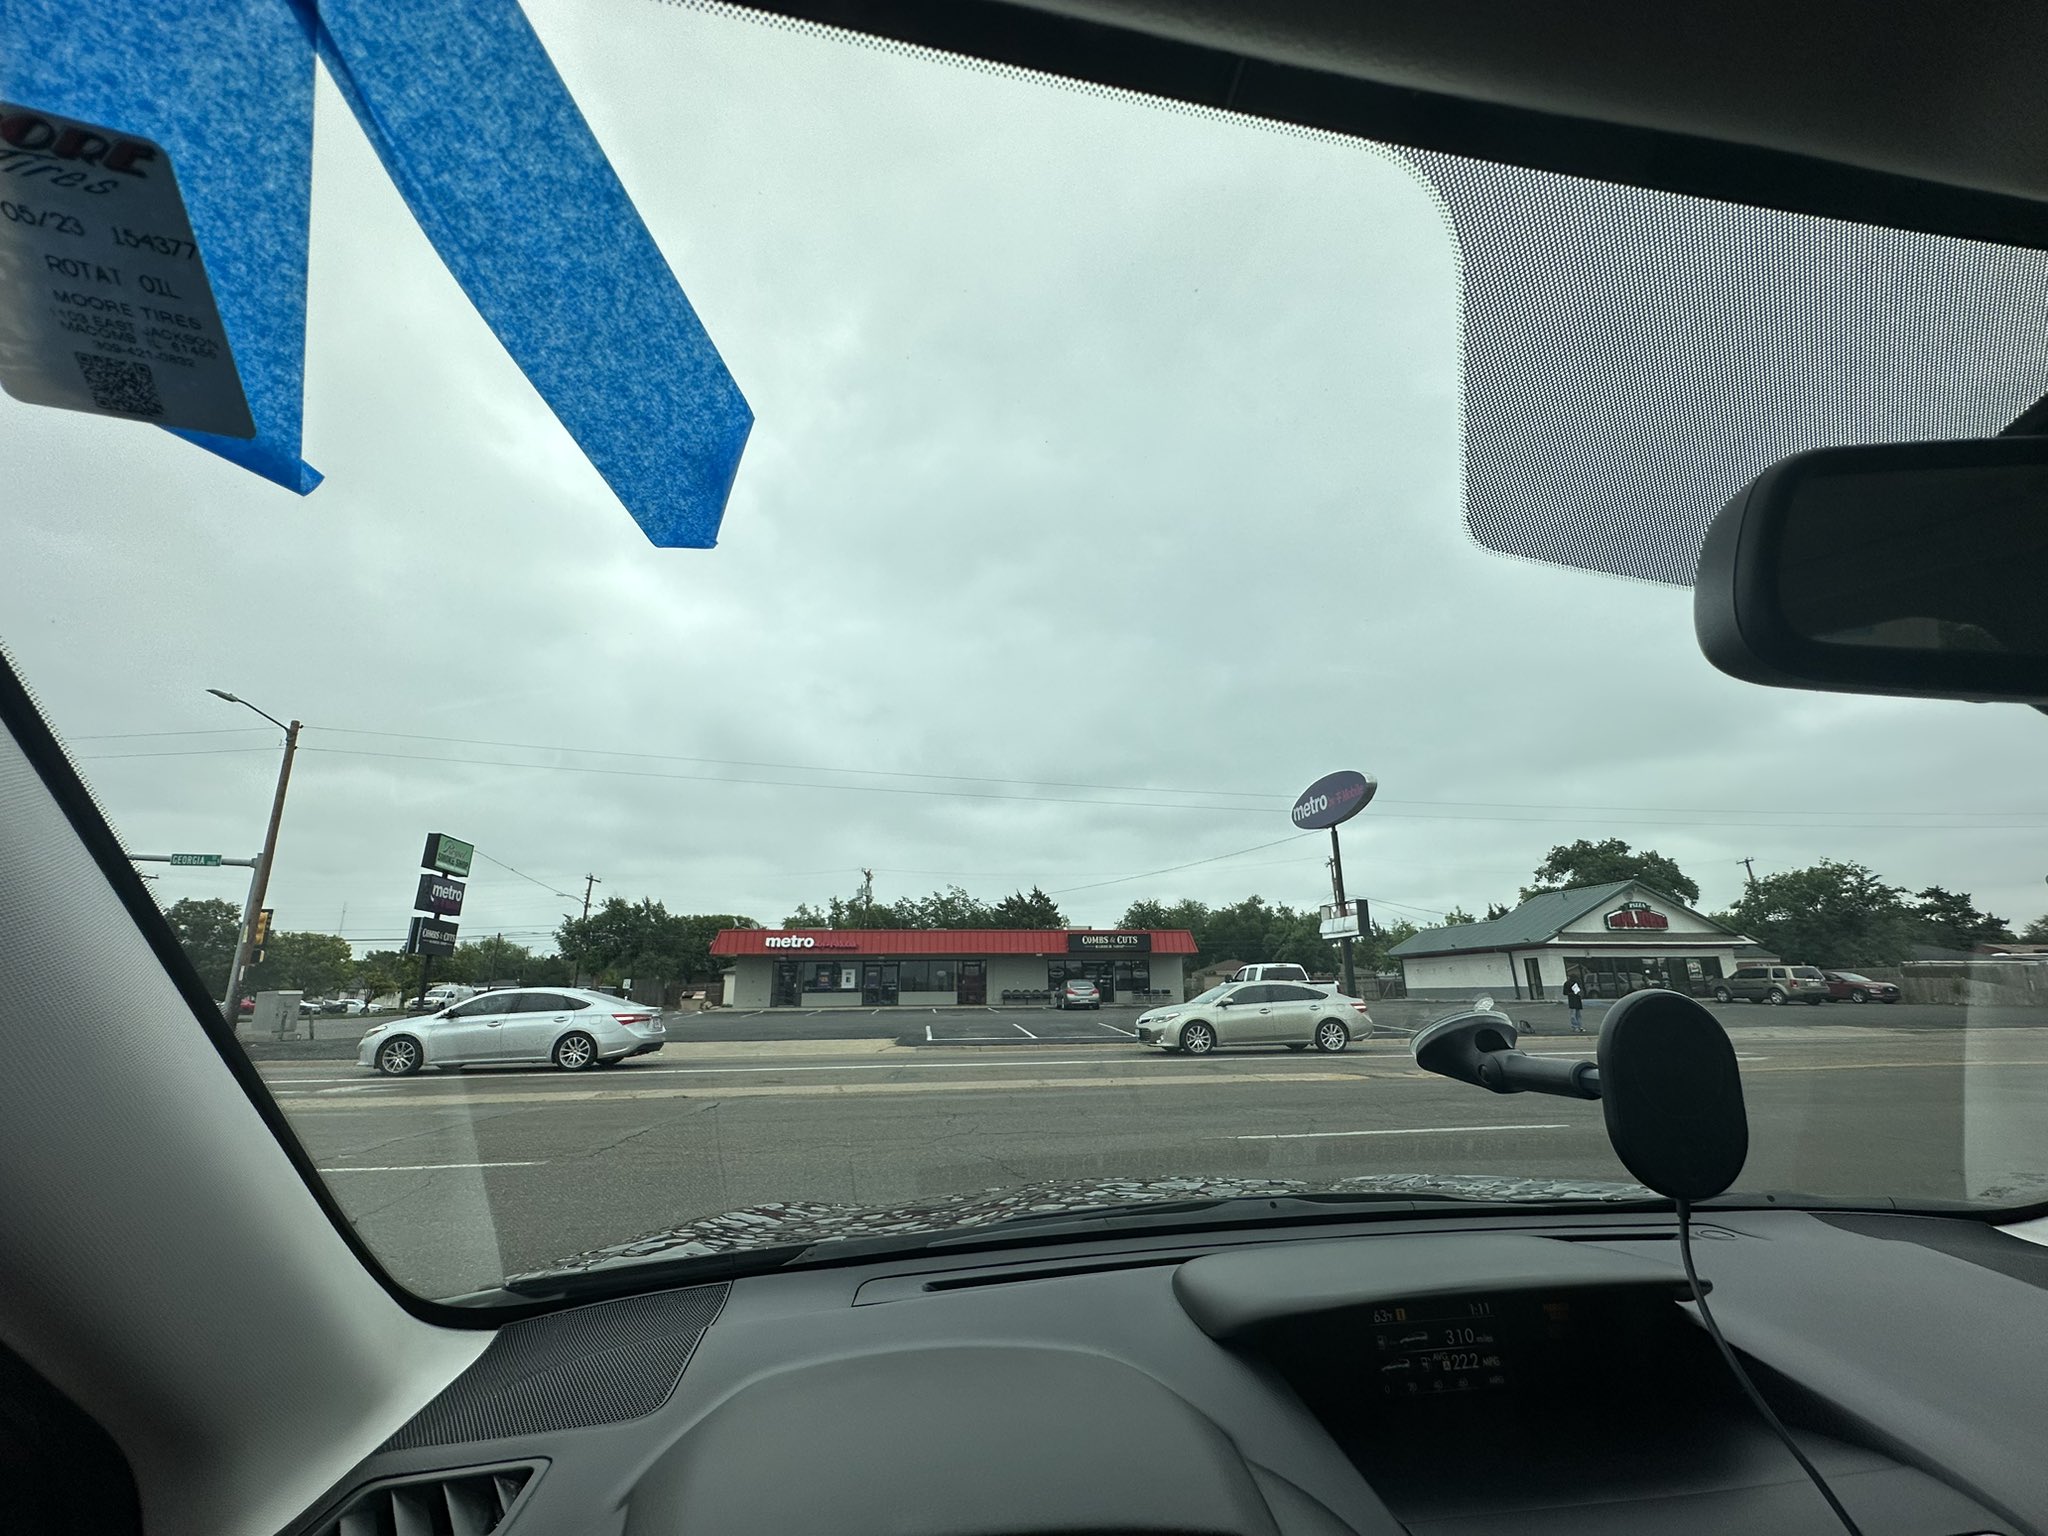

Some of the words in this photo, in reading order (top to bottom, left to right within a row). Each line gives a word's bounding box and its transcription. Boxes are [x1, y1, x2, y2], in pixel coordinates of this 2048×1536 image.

[0, 113, 158, 179] ORE
[112, 226, 197, 259] 154377
[45, 254, 122, 286] ROTAT
[138, 274, 182, 300] OIL
[52, 289, 135, 318] MOORE
[140, 306, 202, 331] TIRES
[1293, 794, 1328, 822] metro
[172, 855, 205, 864] GEORGIA
[432, 883, 462, 902] metro
[765, 935, 815, 948] metro
[1081, 935, 1109, 944] COMBS
[1117, 935, 1138, 944] CUTS
[1445, 1328, 1474, 1345] 310
